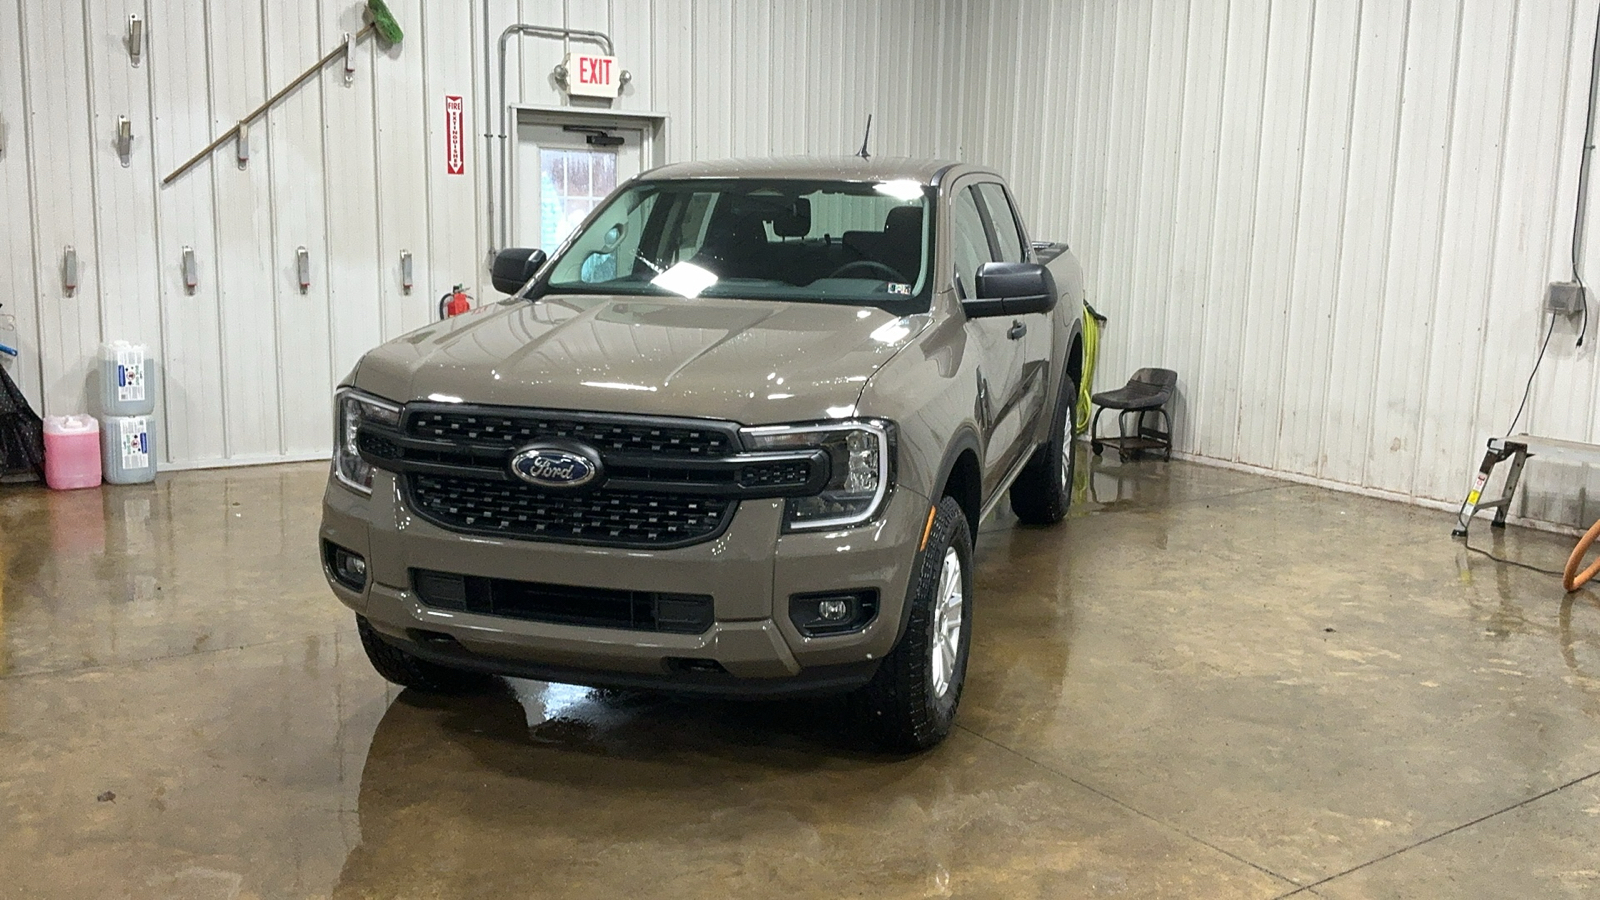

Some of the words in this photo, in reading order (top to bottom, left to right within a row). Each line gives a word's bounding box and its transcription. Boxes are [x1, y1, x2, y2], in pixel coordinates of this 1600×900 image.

[579, 57, 612, 85] EXIT
[447, 102, 461, 110] FIRE
[529, 456, 575, 480] Ford
